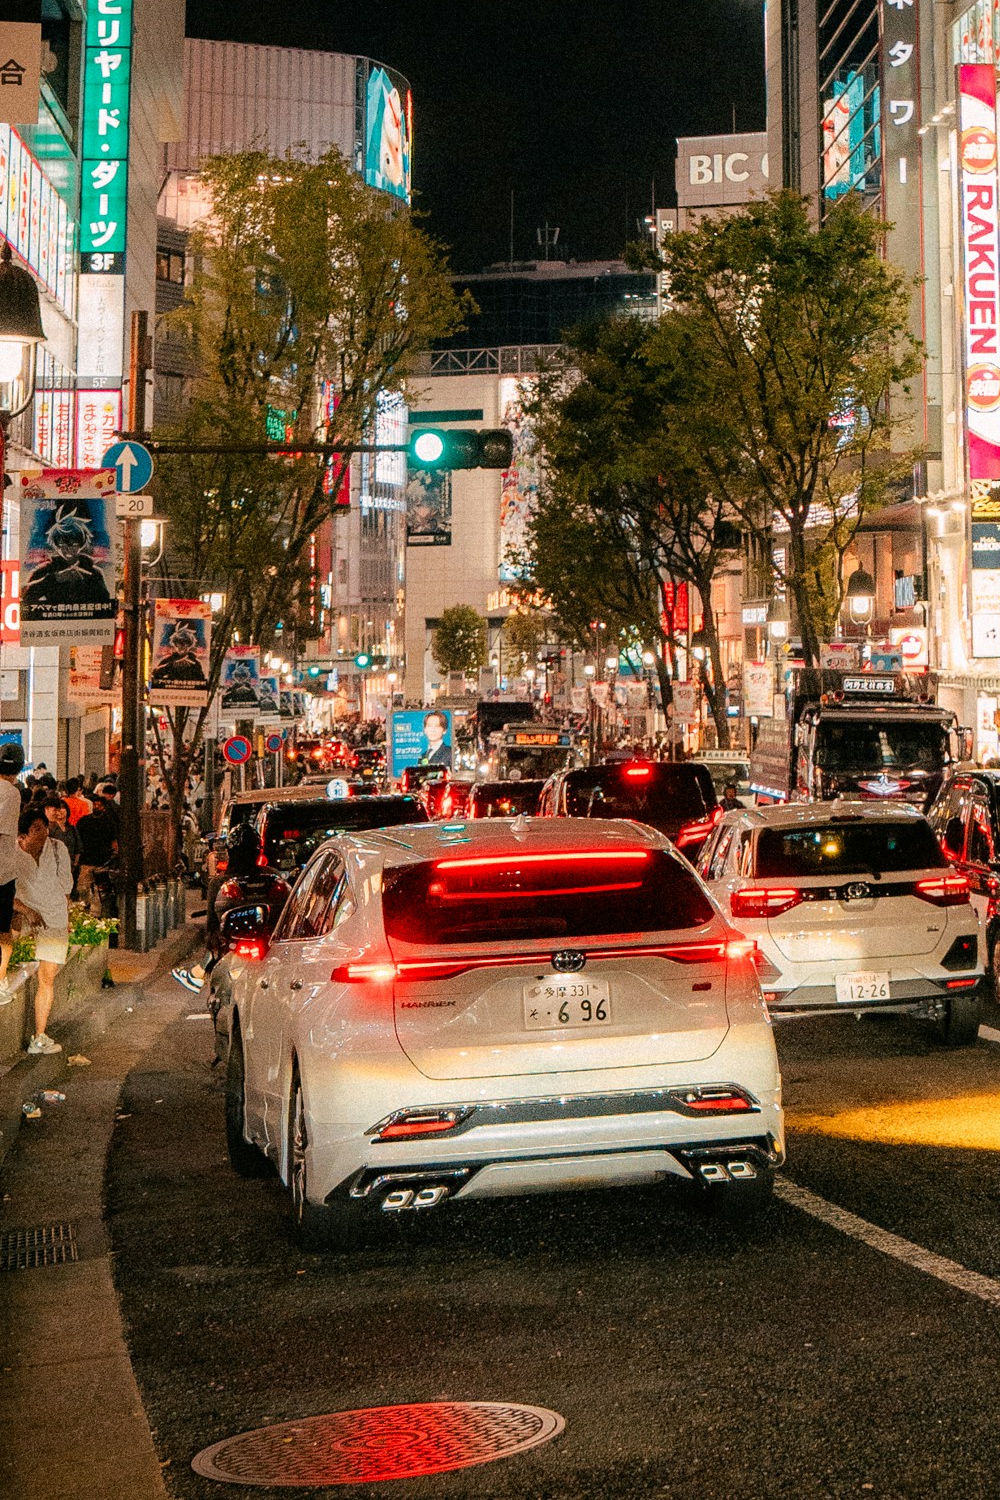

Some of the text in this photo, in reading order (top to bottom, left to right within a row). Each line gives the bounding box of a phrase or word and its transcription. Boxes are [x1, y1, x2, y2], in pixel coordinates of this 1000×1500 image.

[1, 58, 26, 86] 合
[690, 152, 750, 185] BIC
[90, 254, 115, 271] 3F
[967, 184, 998, 354] RAKUEN
[92, 377, 108, 387] 5F
[543, 984, 590, 998] 多摩 331
[850, 984, 887, 999] 12-26
[401, 1000, 457, 1009] HARRIER
